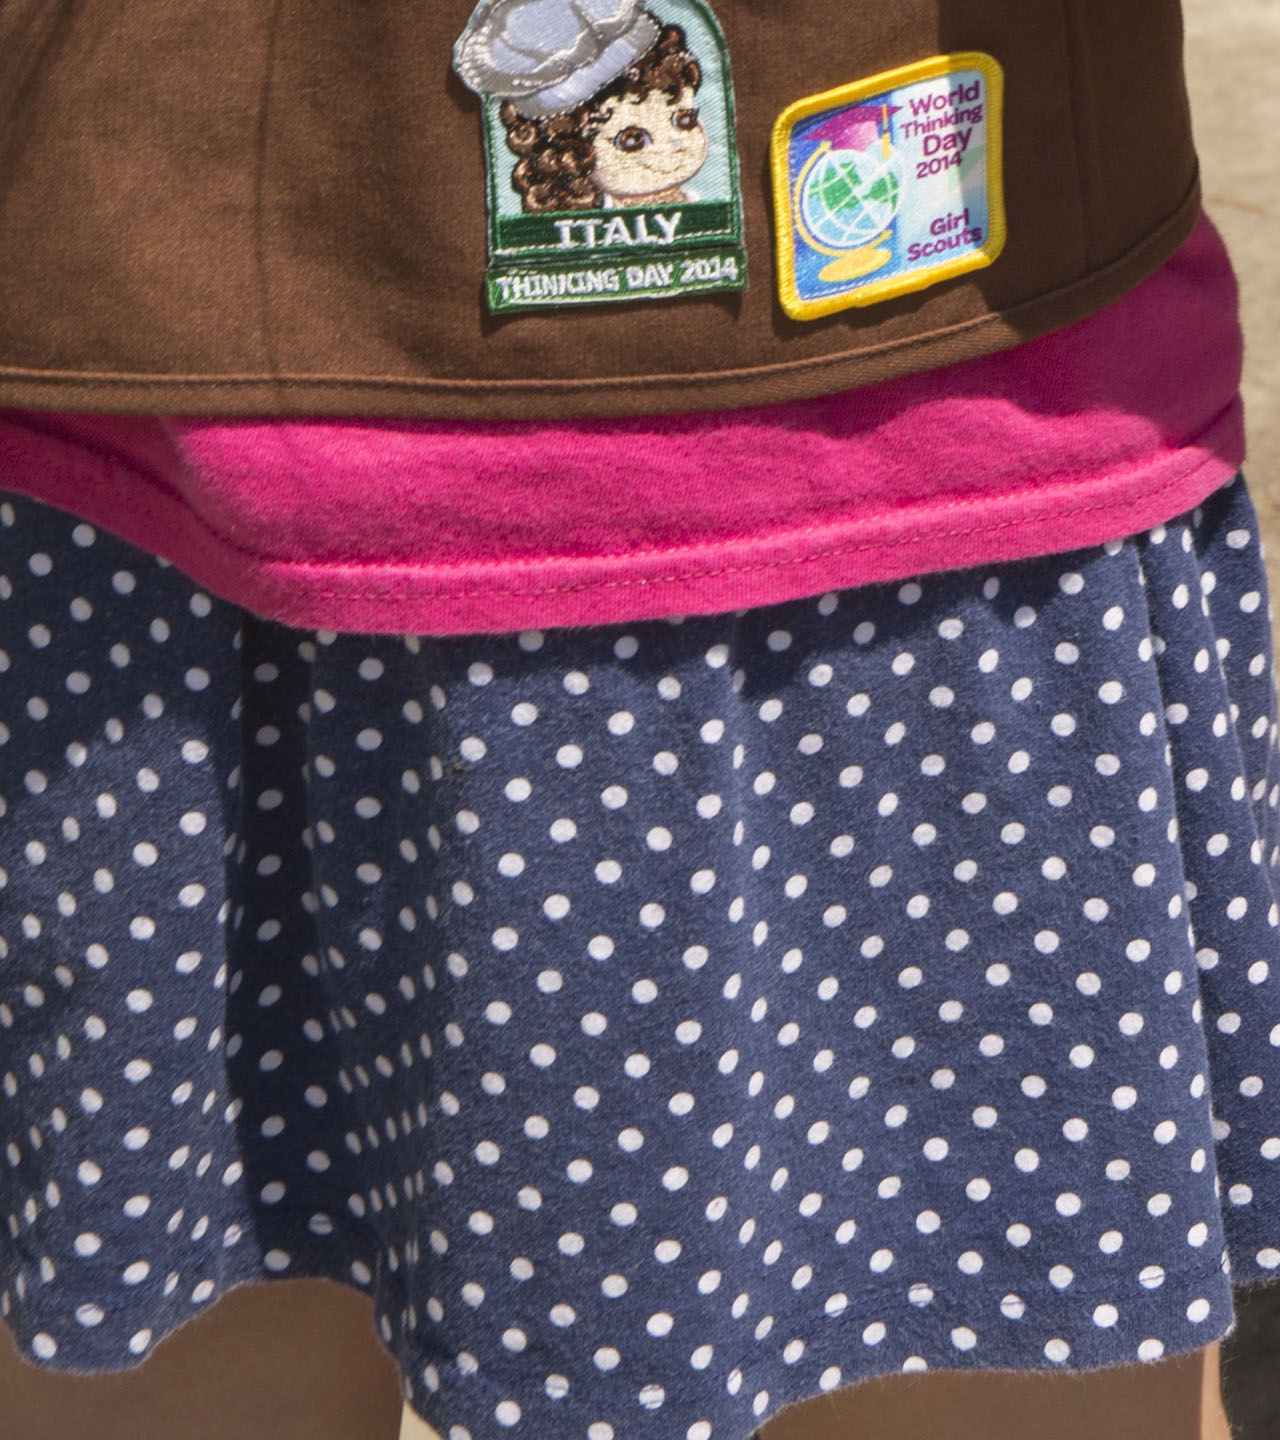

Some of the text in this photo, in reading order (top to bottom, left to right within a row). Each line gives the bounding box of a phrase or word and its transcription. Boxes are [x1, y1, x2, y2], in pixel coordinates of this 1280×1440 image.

[909, 80, 980, 117] World
[900, 104, 984, 139] Thinking
[922, 127, 973, 157] Day
[916, 150, 963, 180] 2014
[554, 211, 683, 249] ITALY
[930, 208, 970, 237] Girl
[907, 226, 983, 262] Scouts
[496, 257, 739, 300] THINKING DAY 2014
